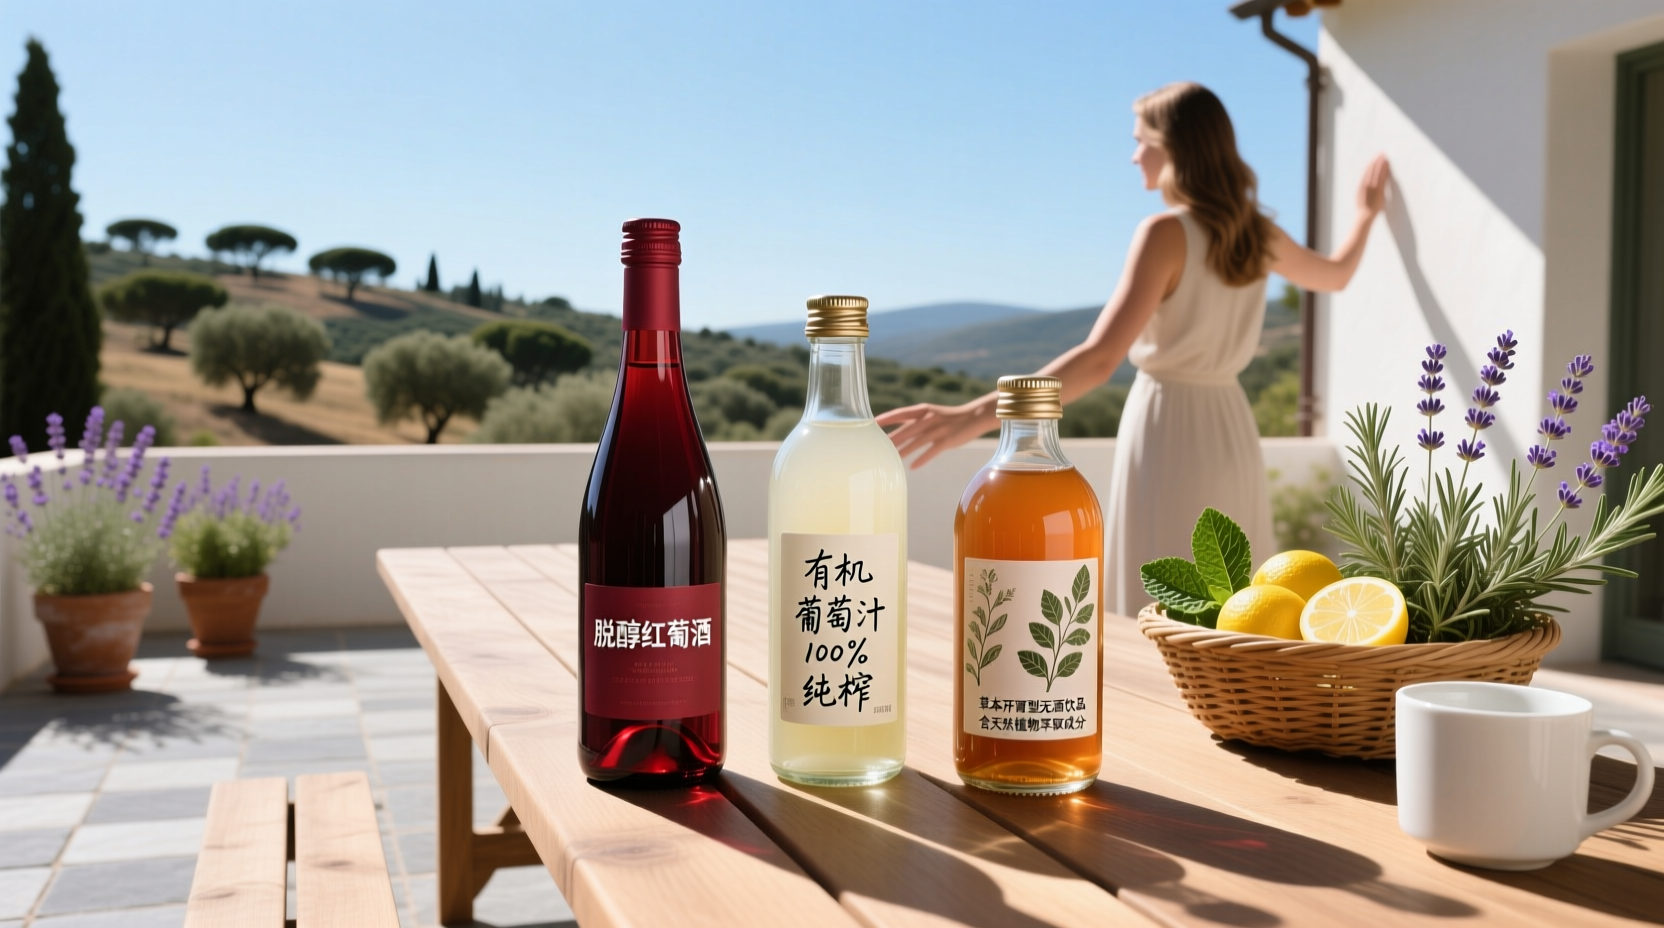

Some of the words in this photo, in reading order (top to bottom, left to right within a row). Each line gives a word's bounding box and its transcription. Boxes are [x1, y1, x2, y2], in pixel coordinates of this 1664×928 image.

[804, 549, 874, 590] 有机
[593, 618, 712, 649] 脱醇红葡酒
[795, 594, 886, 635] 葡萄汁
[804, 637, 869, 669] 100%
[802, 672, 874, 713] 纯榨
